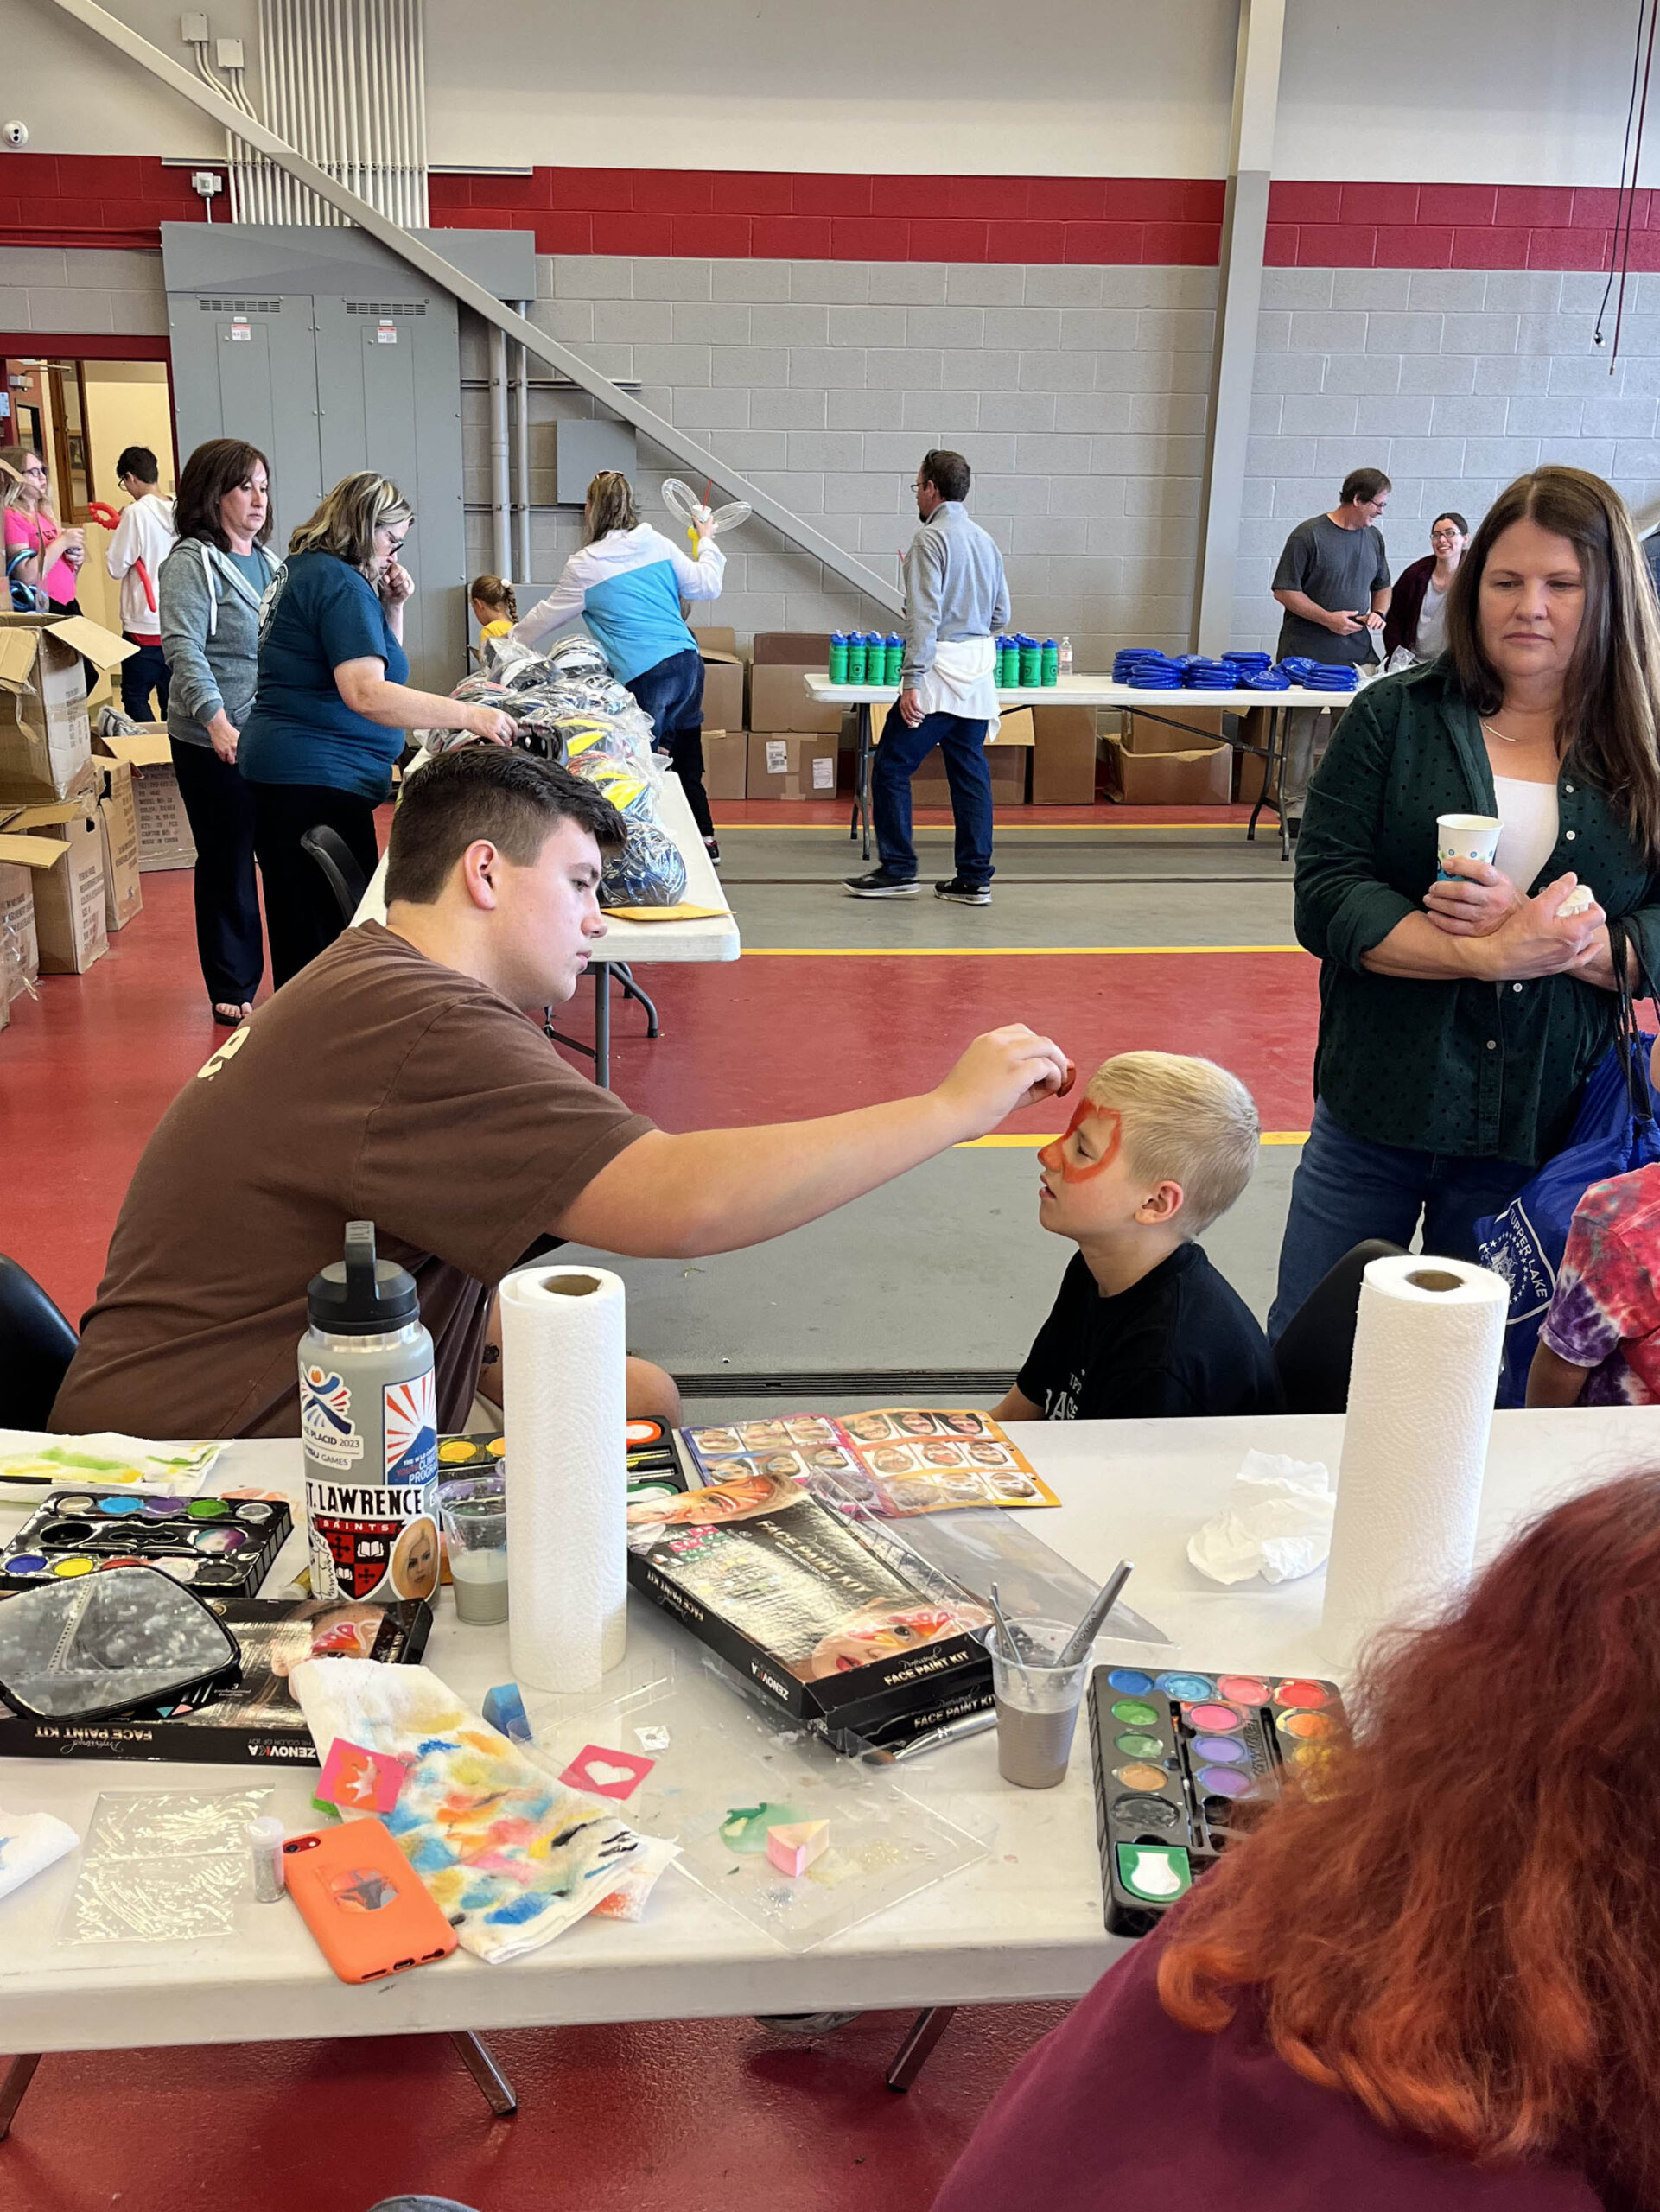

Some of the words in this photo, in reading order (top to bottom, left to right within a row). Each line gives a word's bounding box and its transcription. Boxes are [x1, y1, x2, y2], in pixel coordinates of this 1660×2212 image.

[1509, 1208, 1533, 1256] TUPPER
[1528, 1258, 1548, 1298] LAKE
[340, 1438, 360, 1448] 2023
[321, 1452, 348, 1465] GAMES
[318, 1484, 421, 1515] LAWRENCE
[322, 1517, 390, 1532] SAINTS
[754, 1519, 802, 1545] FACE
[793, 1545, 846, 1574] PAINT
[883, 1669, 916, 1686] FACE
[915, 1657, 951, 1675] PAINT
[949, 1650, 969, 1665] KIT
[913, 1712, 944, 1729] FACE
[945, 1700, 978, 1719] PAINT
[35, 1726, 60, 1738] KIT
[63, 1727, 109, 1739] PAINT
[111, 1728, 153, 1741] FACE
